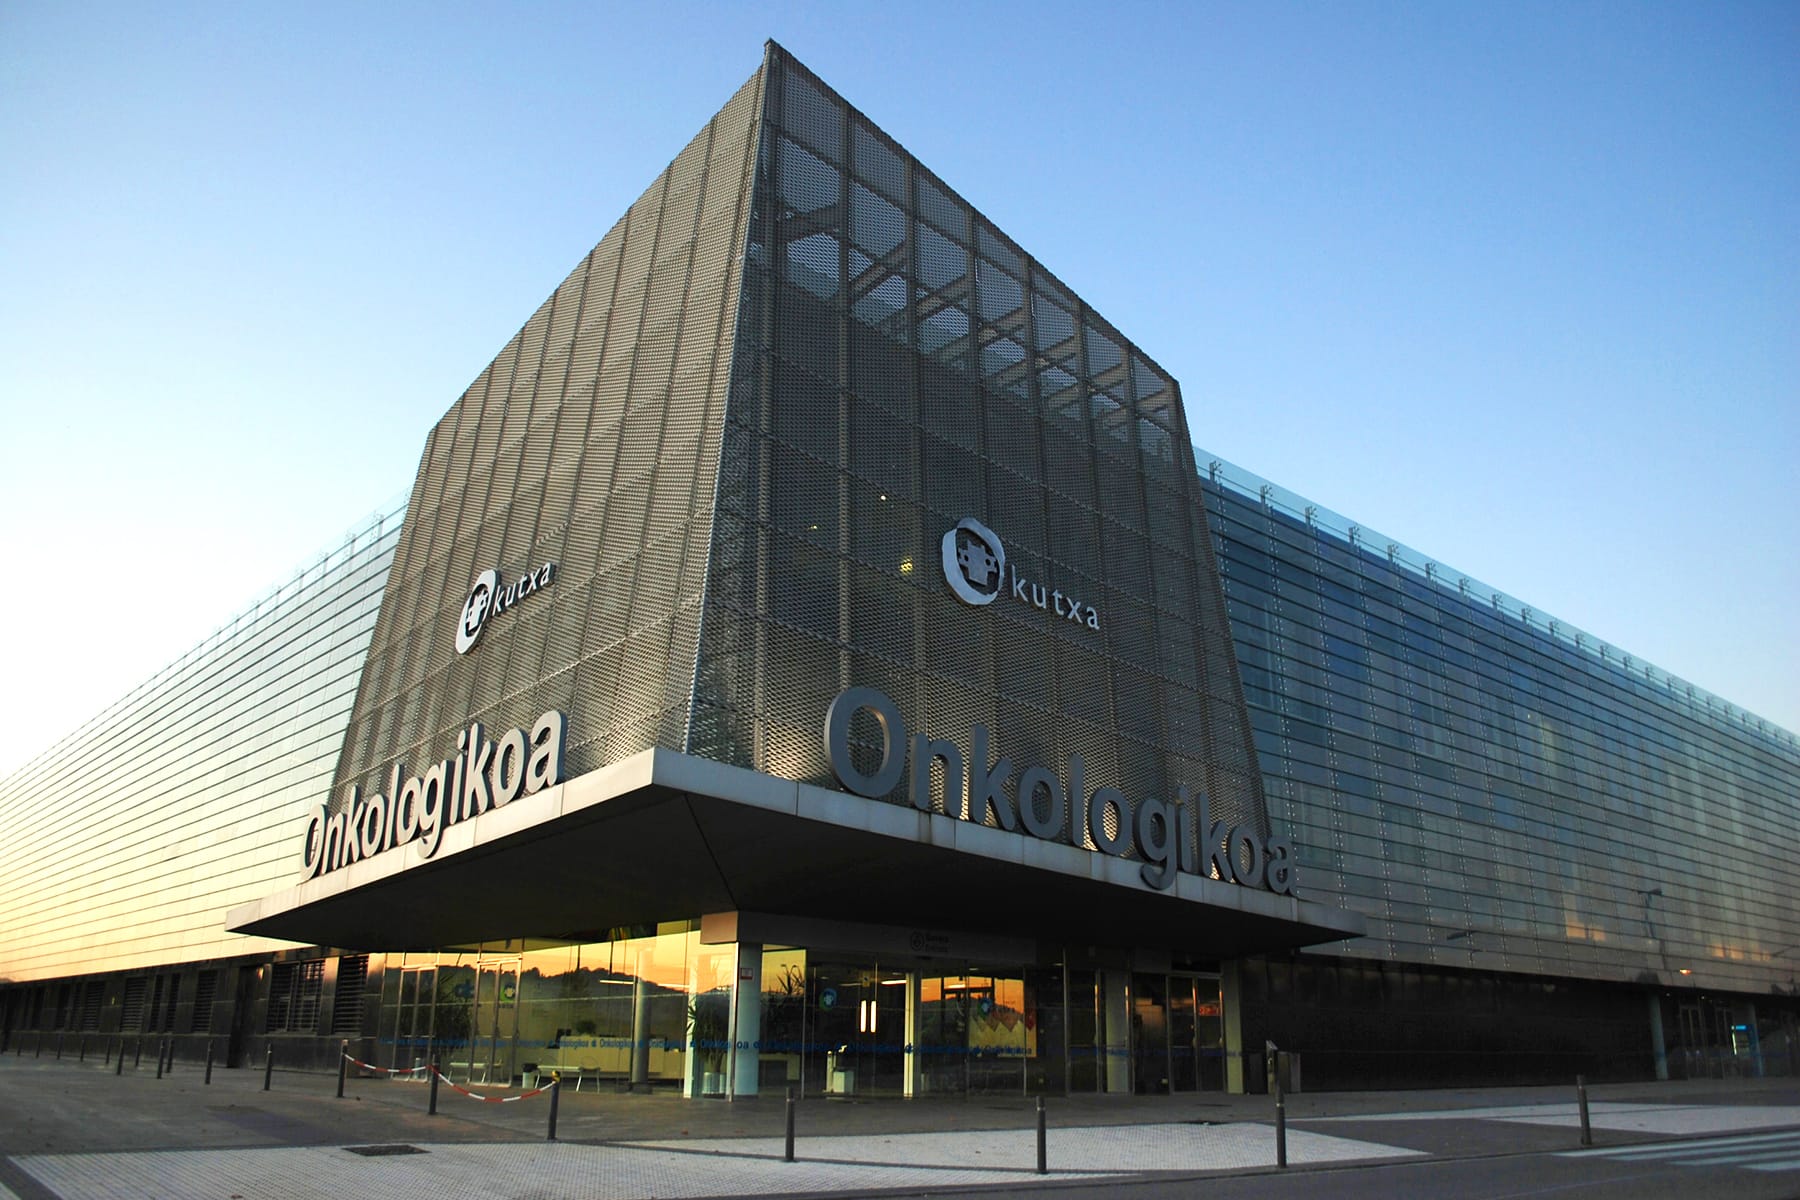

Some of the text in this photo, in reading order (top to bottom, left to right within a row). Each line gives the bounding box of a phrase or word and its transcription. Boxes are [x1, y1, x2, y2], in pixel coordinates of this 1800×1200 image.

[492, 561, 556, 616] kutxa
[1009, 564, 1101, 631] kutxa
[302, 708, 568, 880] Onkologikoa
[823, 686, 1299, 896] Onkologikoa
